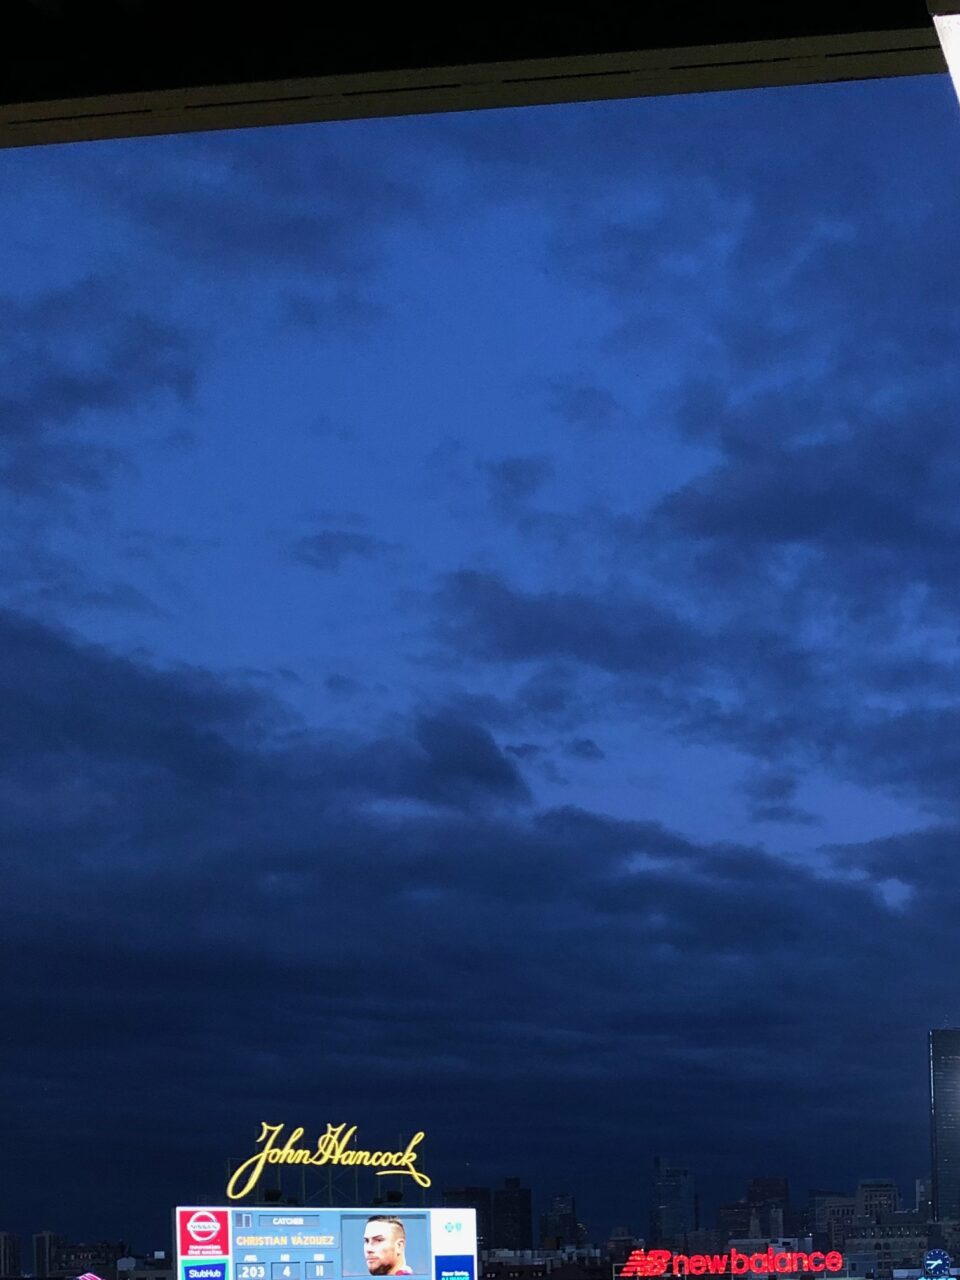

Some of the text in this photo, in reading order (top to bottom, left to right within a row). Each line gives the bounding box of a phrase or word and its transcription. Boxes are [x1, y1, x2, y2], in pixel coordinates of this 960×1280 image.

[226, 1121, 431, 1199] John Hancock
[272, 1217, 304, 1225] CATCHER
[236, 1232, 334, 1246] CHRISTIAN VÁZQUEZ
[672, 1254, 728, 1276] new
[731, 1246, 844, 1276] balance
[188, 1268, 222, 1278] StubHub
[238, 1266, 265, 1278] .203
[282, 1266, 291, 1277] 4
